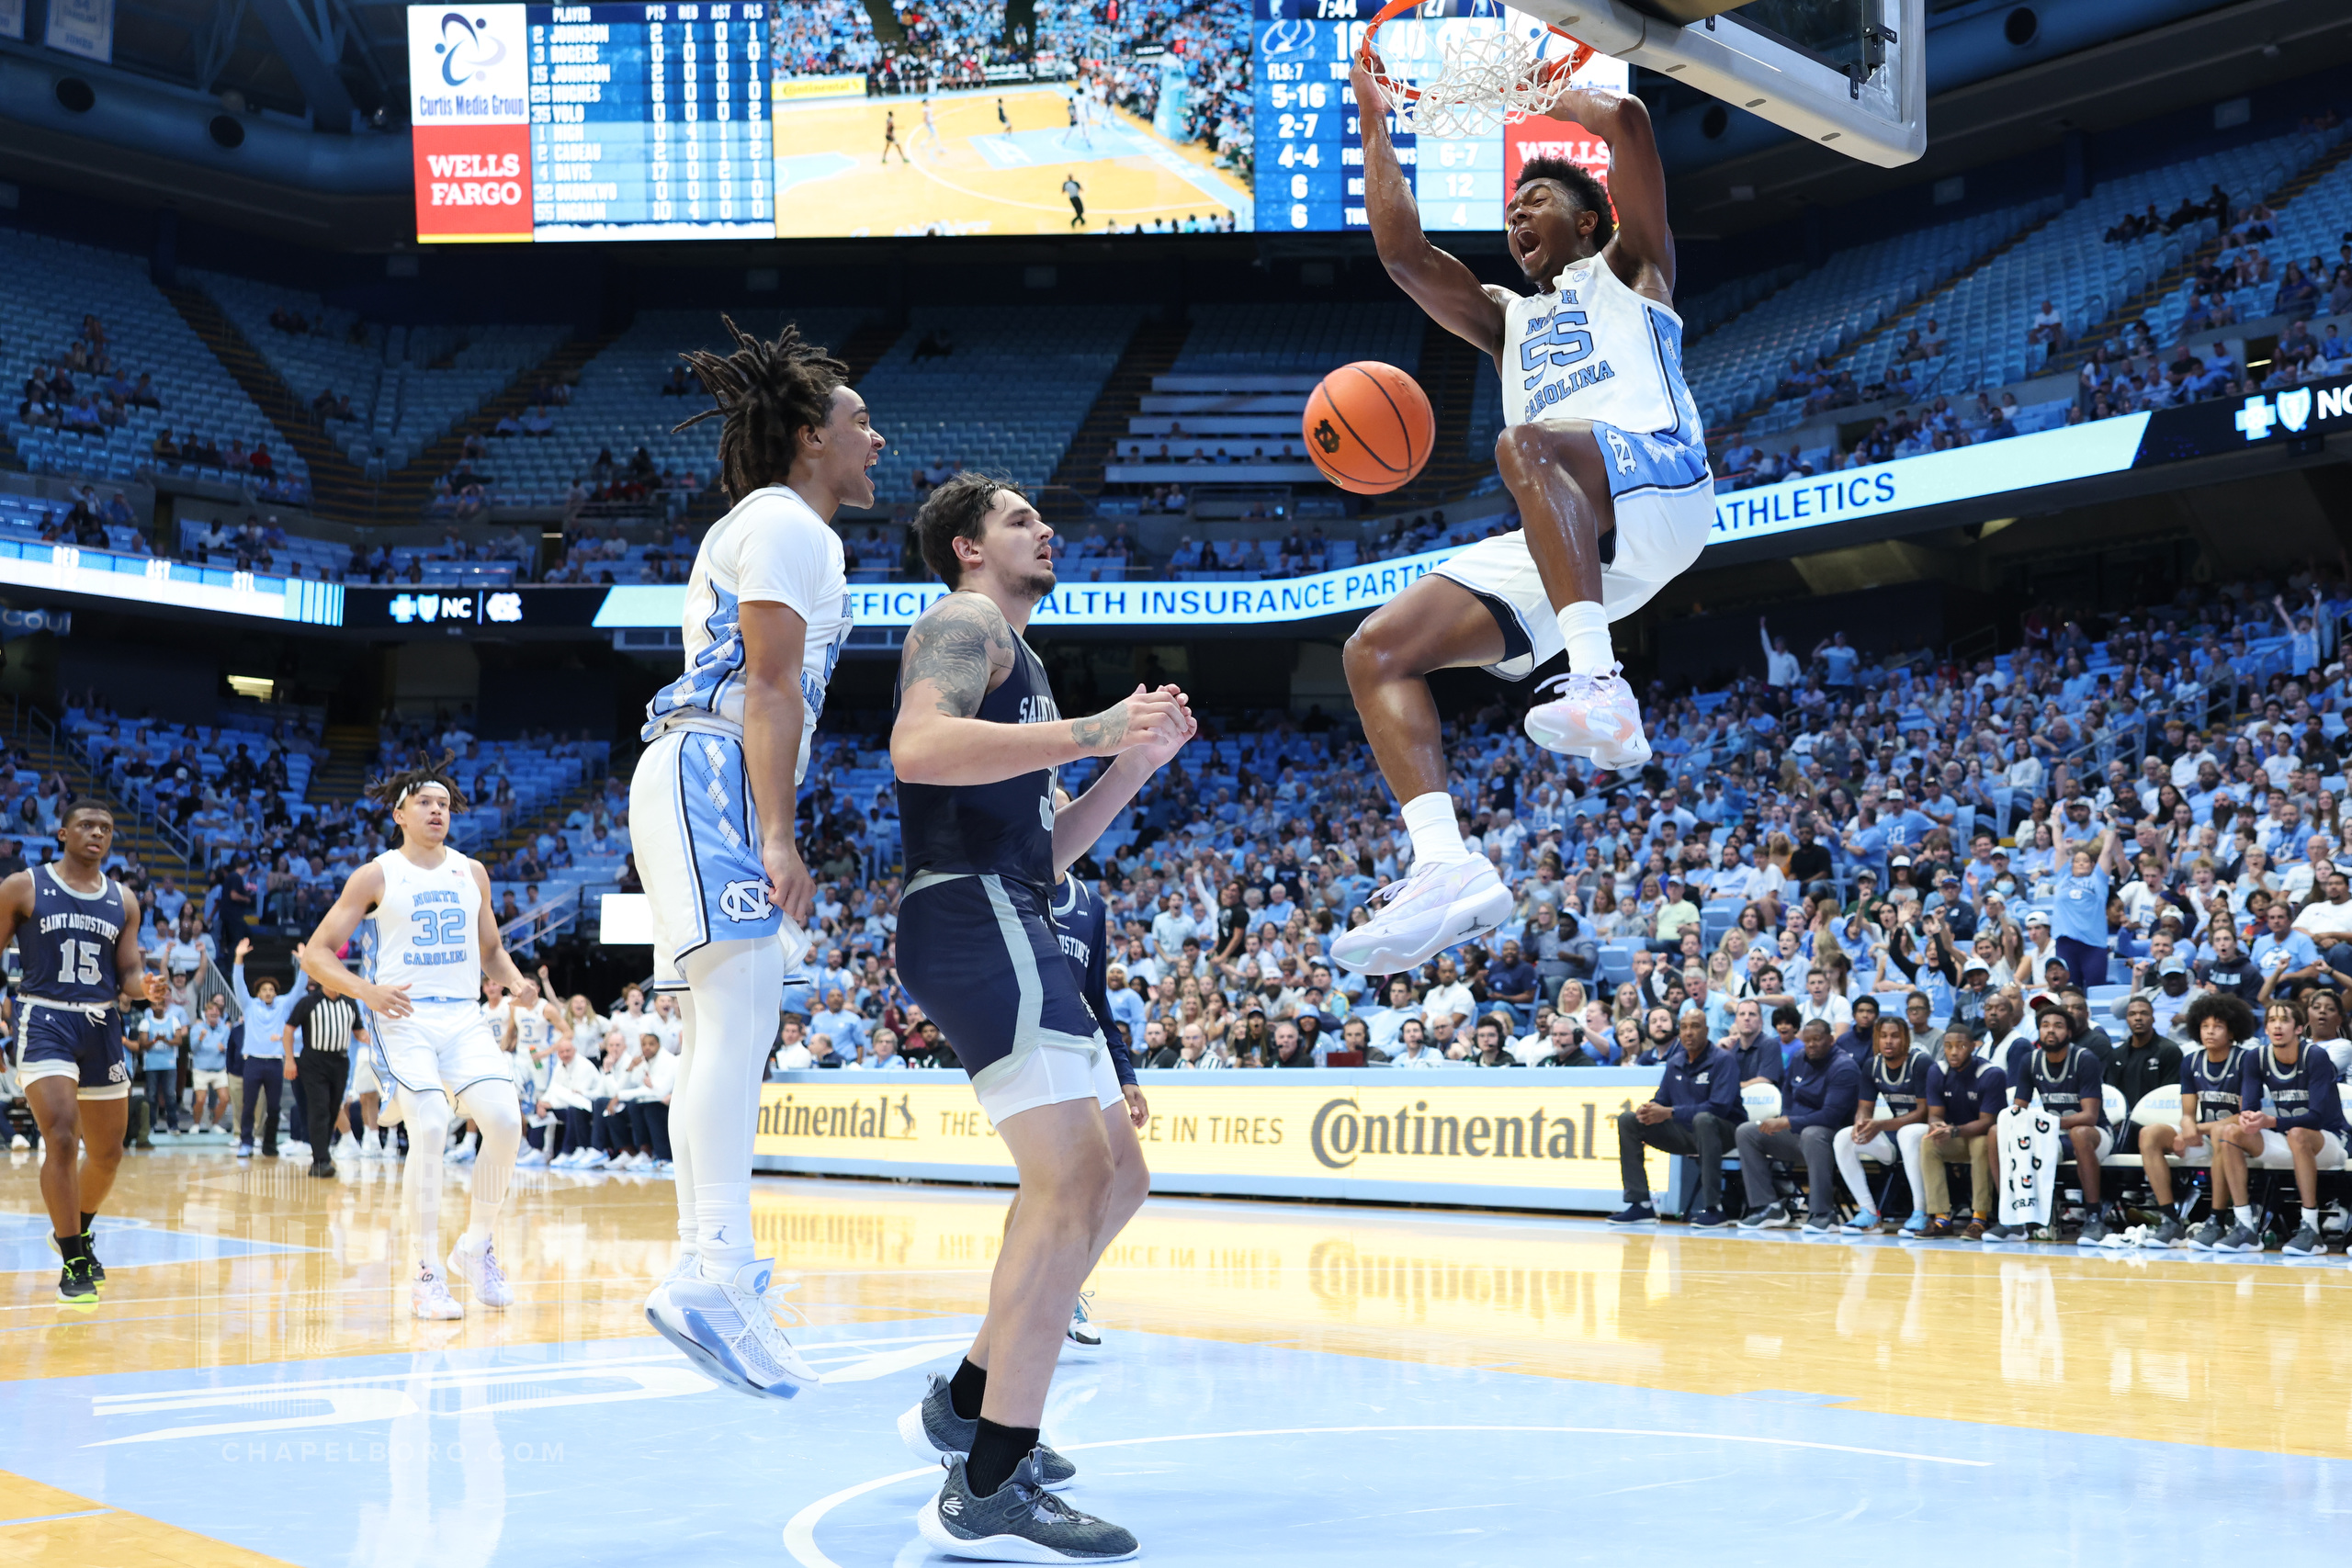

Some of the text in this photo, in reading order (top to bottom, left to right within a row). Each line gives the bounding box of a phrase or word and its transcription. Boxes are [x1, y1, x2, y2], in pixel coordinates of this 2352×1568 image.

[552, 6, 591, 23] PLAYER
[646, 5, 667, 20] PTS
[710, 4, 731, 19] AST
[743, 3, 763, 19] FLS
[533, 20, 758, 44] 2 JOHNSON 2 1 0 1
[534, 40, 761, 63] 3 ROGERS 0 0 0 0
[531, 61, 759, 84] 15 JOHNSON 2 0 0 1
[530, 85, 550, 103] 25
[684, 81, 697, 101] 0
[717, 81, 729, 100] 0
[748, 80, 762, 100] 0
[1272, 84, 1326, 109] 5-16
[420, 94, 524, 117] Curtis Media Group
[531, 100, 762, 123] 35 VOLO 0 0 0 2
[538, 125, 546, 142] 1
[653, 122, 666, 141] 0
[685, 121, 697, 141] 4
[719, 120, 728, 141] 1
[750, 120, 763, 140] 0
[1278, 113, 1319, 139] 2-7
[537, 140, 763, 162] 2 CADEAU 2 0 1 2
[1278, 143, 1319, 169] 4-4
[1440, 142, 1479, 167] 6-7
[426, 153, 521, 177] WELLS
[538, 159, 762, 182] 4 DAVIS 17 0 2 1
[430, 181, 522, 206] FARGO
[533, 184, 553, 201] 32
[655, 181, 668, 201] 0
[687, 180, 700, 200] 0
[718, 180, 732, 199] 0
[751, 179, 763, 199] 0
[1291, 173, 1474, 199] 6 12
[534, 202, 555, 221] 55
[652, 200, 673, 220] 10
[688, 200, 700, 220] 4
[719, 199, 733, 220] 0
[752, 199, 764, 220] 0
[1291, 203, 1467, 229] 6 4
[1520, 310, 1594, 390] 55
[1525, 360, 1615, 423] CAROLINA
[441, 597, 471, 618] NC
[1036, 591, 1126, 615] ALTH
[1142, 581, 1335, 615] INSURANCE
[413, 890, 460, 907] NORTH
[40, 913, 68, 934] SAINT
[412, 908, 466, 946] 32
[58, 938, 103, 986] 15
[756, 1093, 888, 1138] ntinental
[940, 1111, 979, 1136] THE
[1171, 1115, 1198, 1143] IN
[1208, 1116, 1283, 1145] TIRES
[1311, 1098, 1598, 1169] Continental
